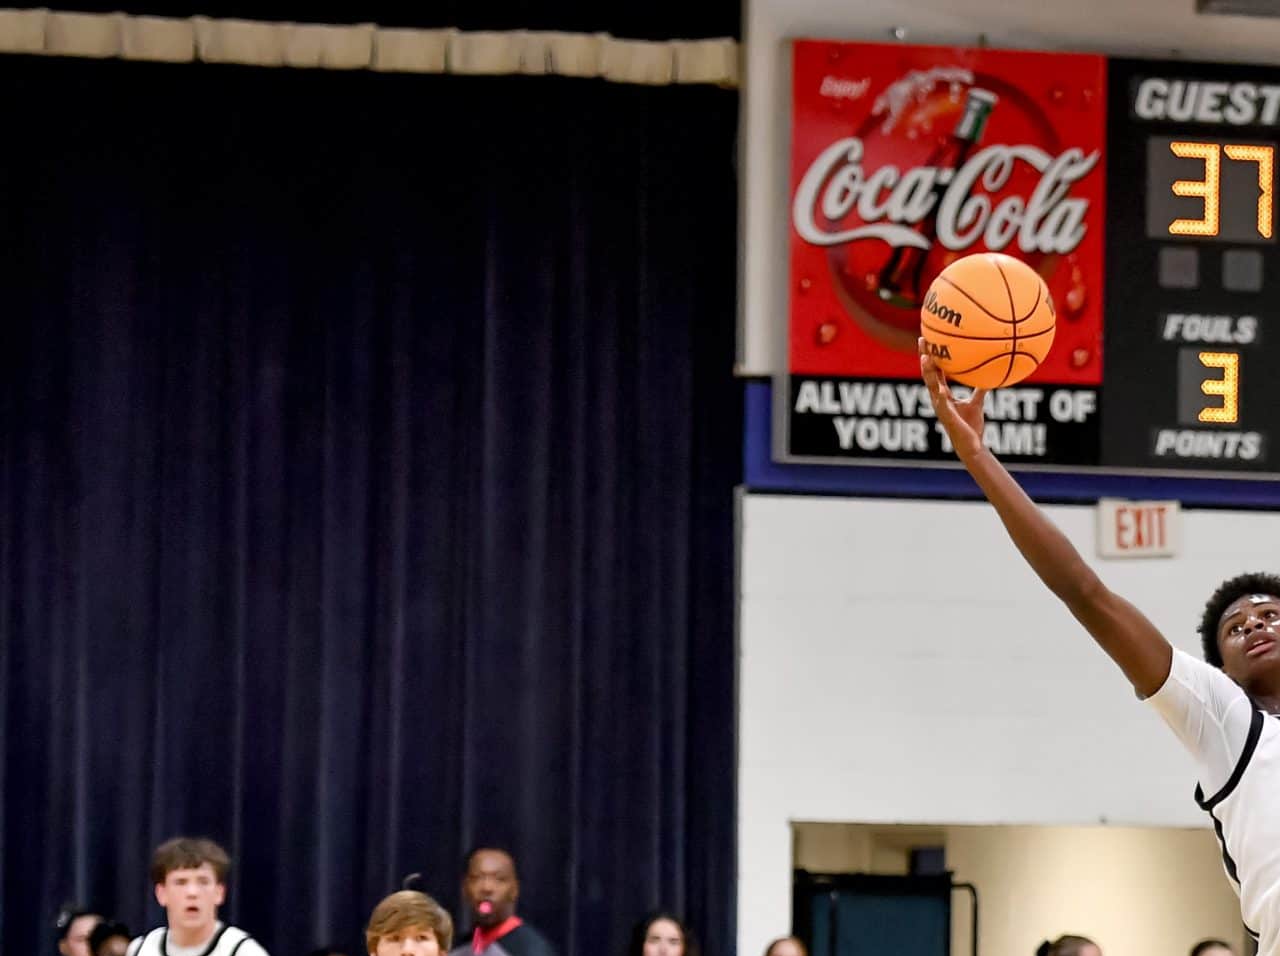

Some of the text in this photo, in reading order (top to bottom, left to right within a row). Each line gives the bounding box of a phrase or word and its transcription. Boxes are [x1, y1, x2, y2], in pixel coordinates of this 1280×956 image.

[1168, 142, 1274, 239] 37
[1163, 313, 1258, 344] FOULS
[795, 380, 940, 417] ALWAYS
[1049, 388, 1097, 422] OF
[1198, 351, 1240, 423] 3
[833, 415, 929, 452] YOUR
[1155, 430, 1261, 460] POINTS
[1115, 504, 1167, 550] EXIT
